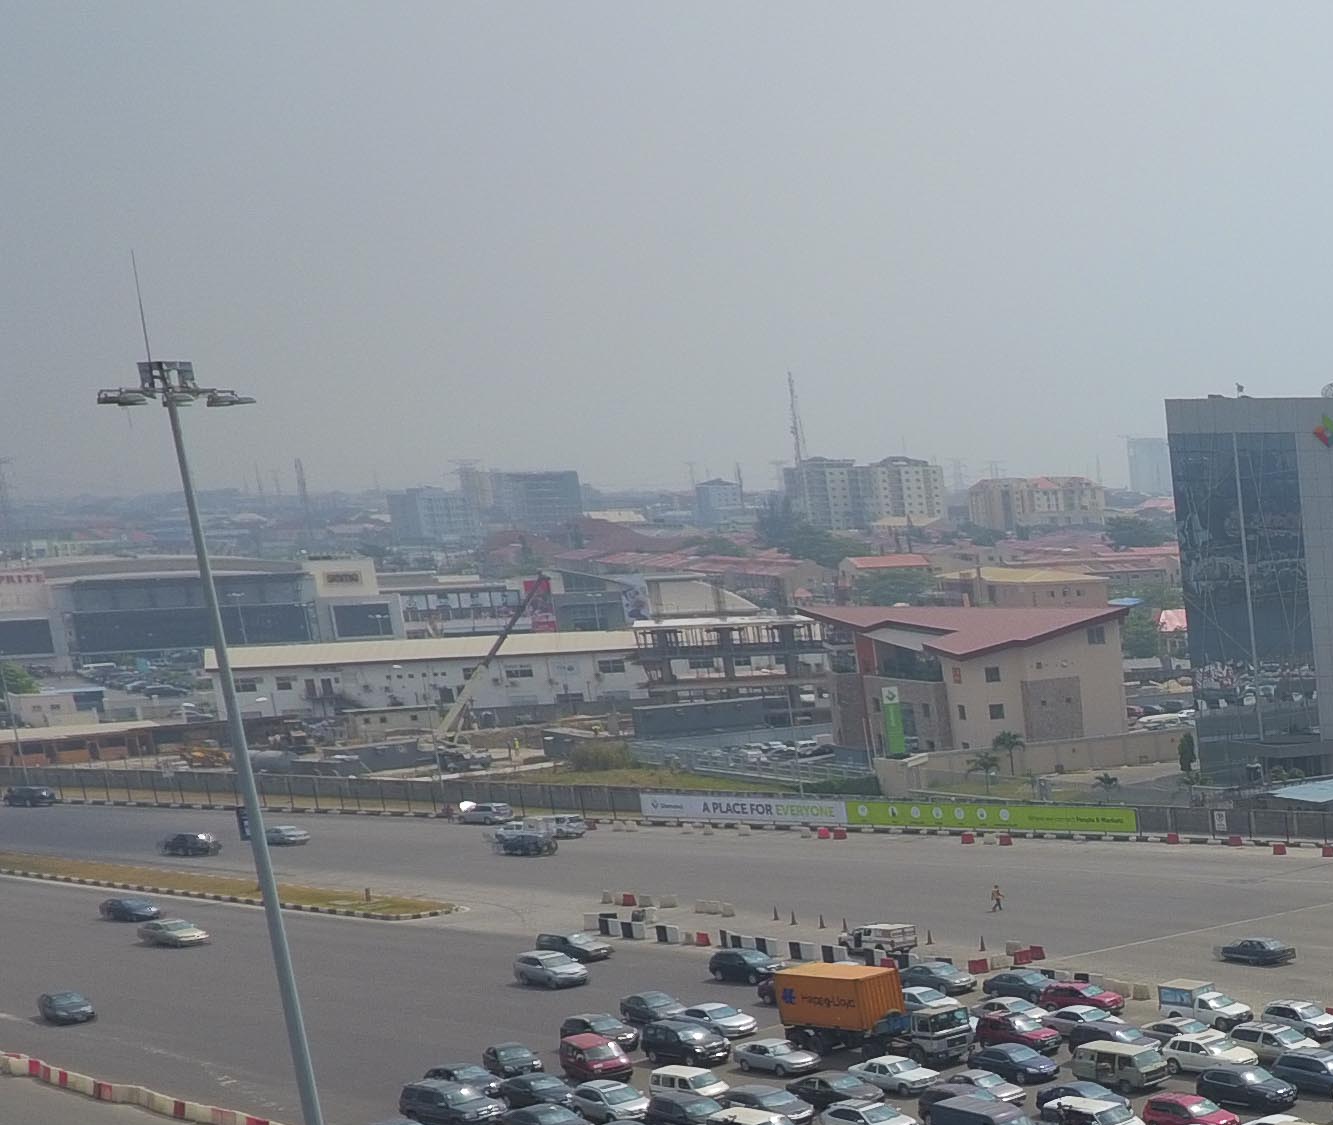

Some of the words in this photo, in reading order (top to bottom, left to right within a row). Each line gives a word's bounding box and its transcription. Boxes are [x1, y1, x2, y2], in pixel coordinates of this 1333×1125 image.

[702, 801, 710, 813] A
[712, 802, 747, 815] PLACE
[750, 803, 773, 816] FOR
[775, 804, 835, 818] EVERYONE
